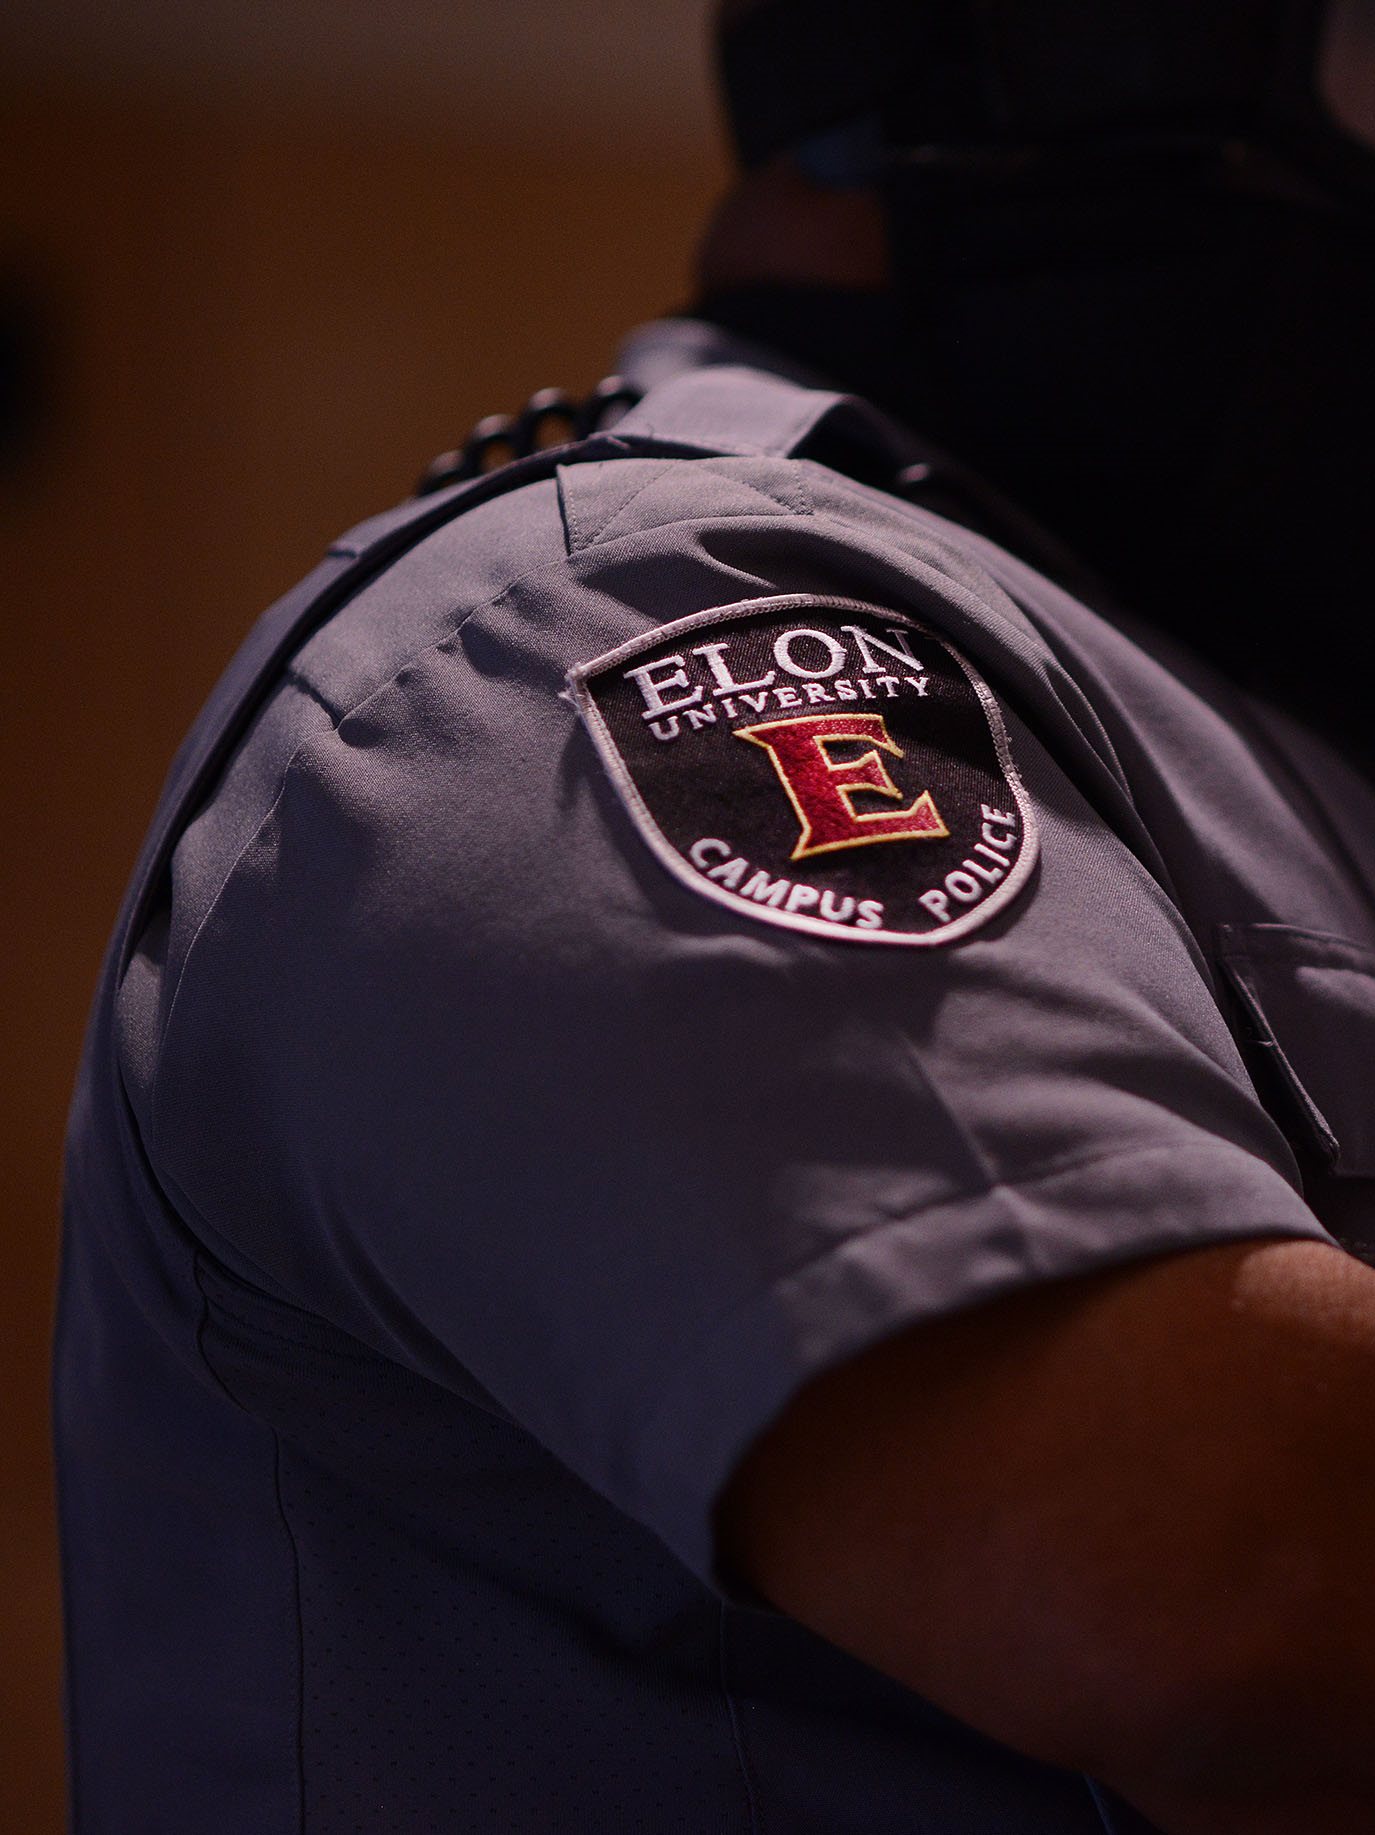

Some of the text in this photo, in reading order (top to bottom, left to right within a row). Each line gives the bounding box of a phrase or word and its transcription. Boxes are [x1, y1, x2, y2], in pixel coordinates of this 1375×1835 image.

[624, 625, 925, 719] ELON
[648, 676, 930, 741] UNIVERSITY
[732, 713, 950, 860] E
[689, 804, 1016, 929] CAMPUS POLICE
